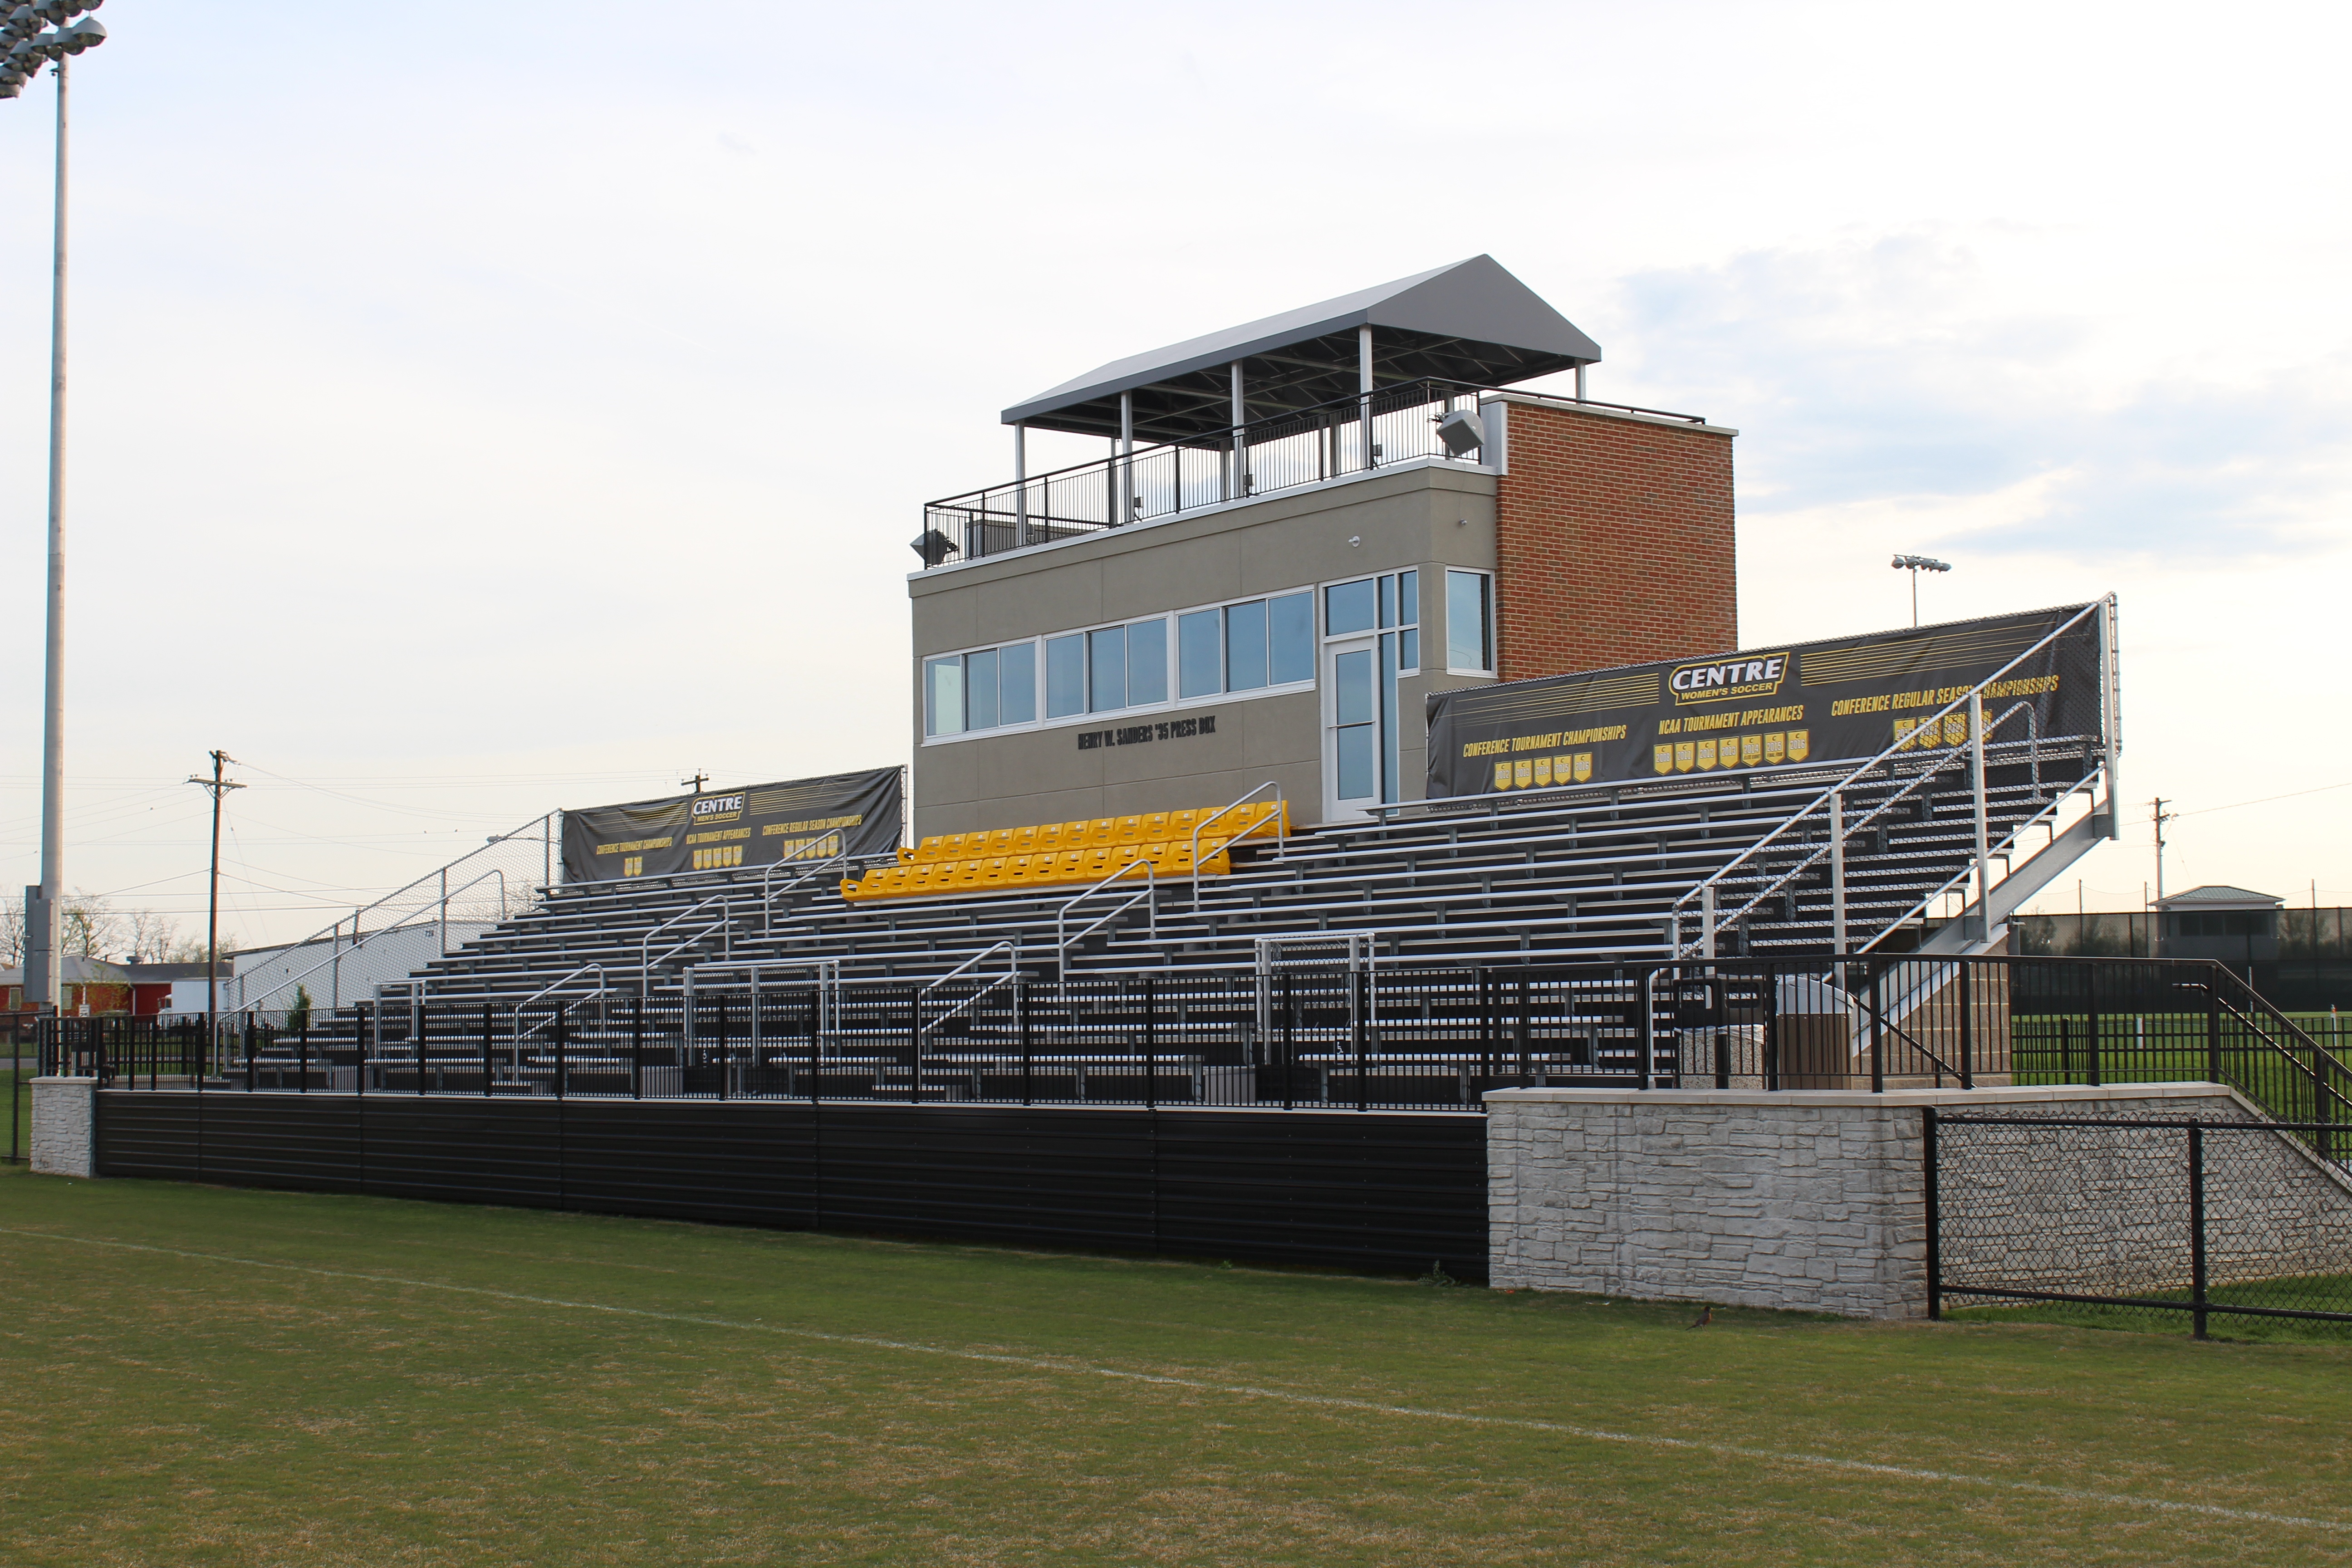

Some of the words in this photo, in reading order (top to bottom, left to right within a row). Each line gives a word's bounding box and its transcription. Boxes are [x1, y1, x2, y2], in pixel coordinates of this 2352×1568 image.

[1672, 658, 1783, 690] CENTRE
[1681, 687, 1728, 700] WOMEN'S
[1730, 682, 1773, 694] SOCCER
[1831, 694, 1890, 717] CONFERENCE
[1892, 689, 1936, 710] REGULAR
[1977, 675, 2059, 699] HAMPIONSHIPS
[1078, 731, 1103, 750] HENRY
[1104, 730, 1115, 747] W.
[1117, 725, 1153, 745] SANDERS
[1155, 722, 1168, 740] '35
[1171, 718, 1196, 738] PRESS
[1199, 715, 1216, 734] BOX
[1658, 718, 1681, 735] NCAA
[1683, 711, 1740, 732] TOURNAMENT
[1740, 705, 1804, 726] APPEARANCES
[1463, 738, 1510, 758] CONFERENCE
[1512, 732, 1562, 752] TOURNAMENT
[1563, 724, 1627, 746] CHAMPIONSHIPS
[1656, 753, 1670, 763] 2008
[1677, 750, 1691, 761] 2011
[1700, 748, 1715, 759] 2012
[1721, 746, 1736, 756] 2013
[1744, 744, 1759, 754] 2014
[1767, 741, 1782, 752] 2015
[1790, 739, 1805, 750] 2016
[1497, 769, 1509, 779] 2012
[1516, 767, 1530, 778] 2013
[1536, 765, 1549, 776] 2014
[1555, 763, 1569, 774] 2015
[1575, 761, 1589, 772] 2016
[693, 796, 742, 815] CENTRE
[715, 812, 737, 820] SOCCER
